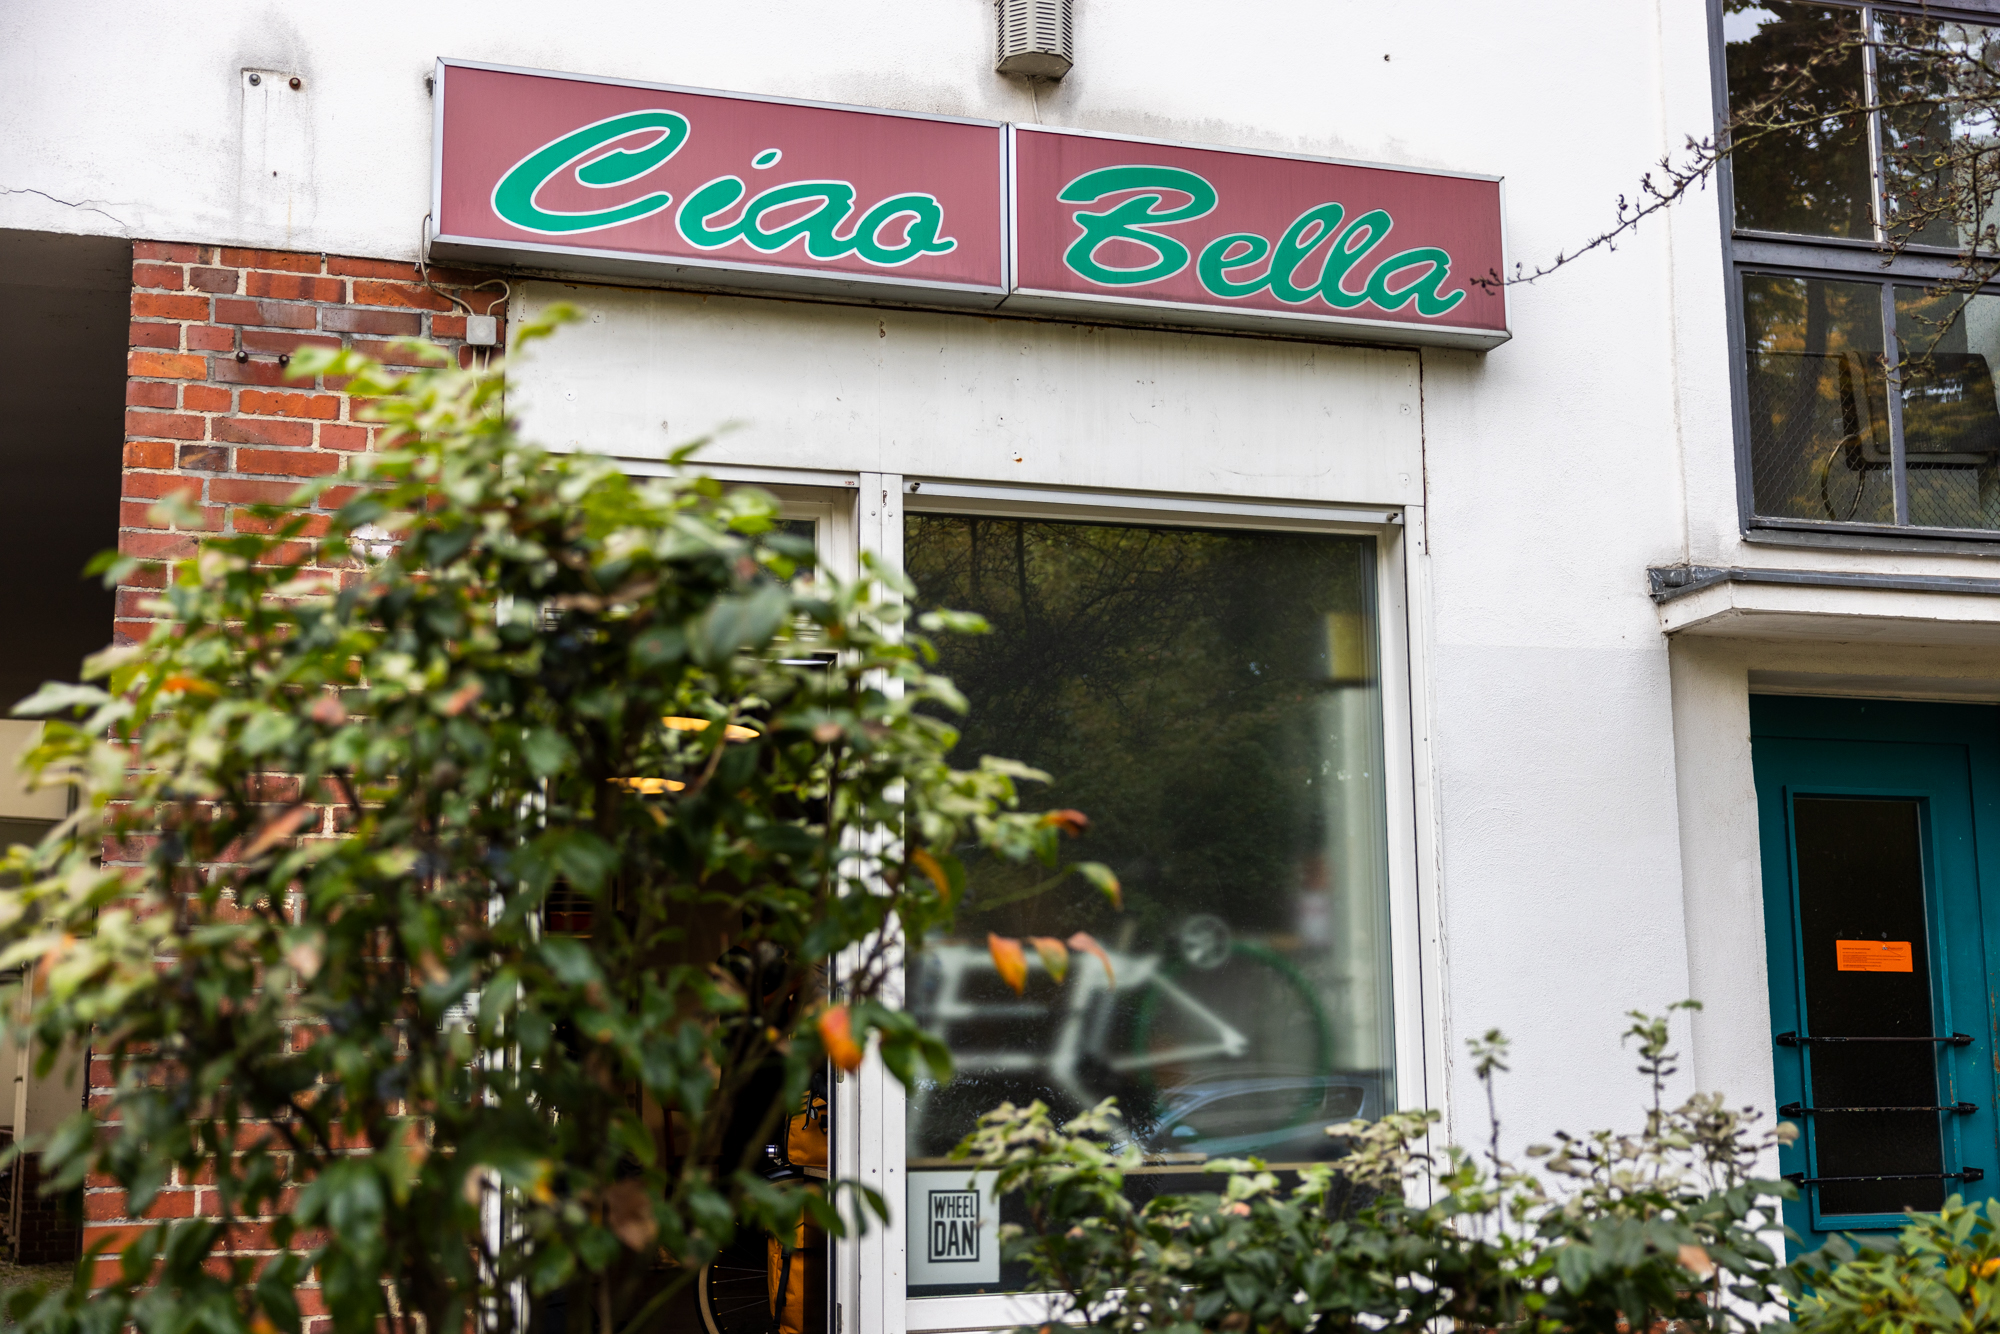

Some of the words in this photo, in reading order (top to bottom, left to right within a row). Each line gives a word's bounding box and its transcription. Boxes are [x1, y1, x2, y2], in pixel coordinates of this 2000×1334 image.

[491, 109, 957, 267] Ciao
[1056, 165, 1466, 317] Bella
[934, 1195, 975, 1219] WHEEL
[934, 1220, 975, 1257] DAN
